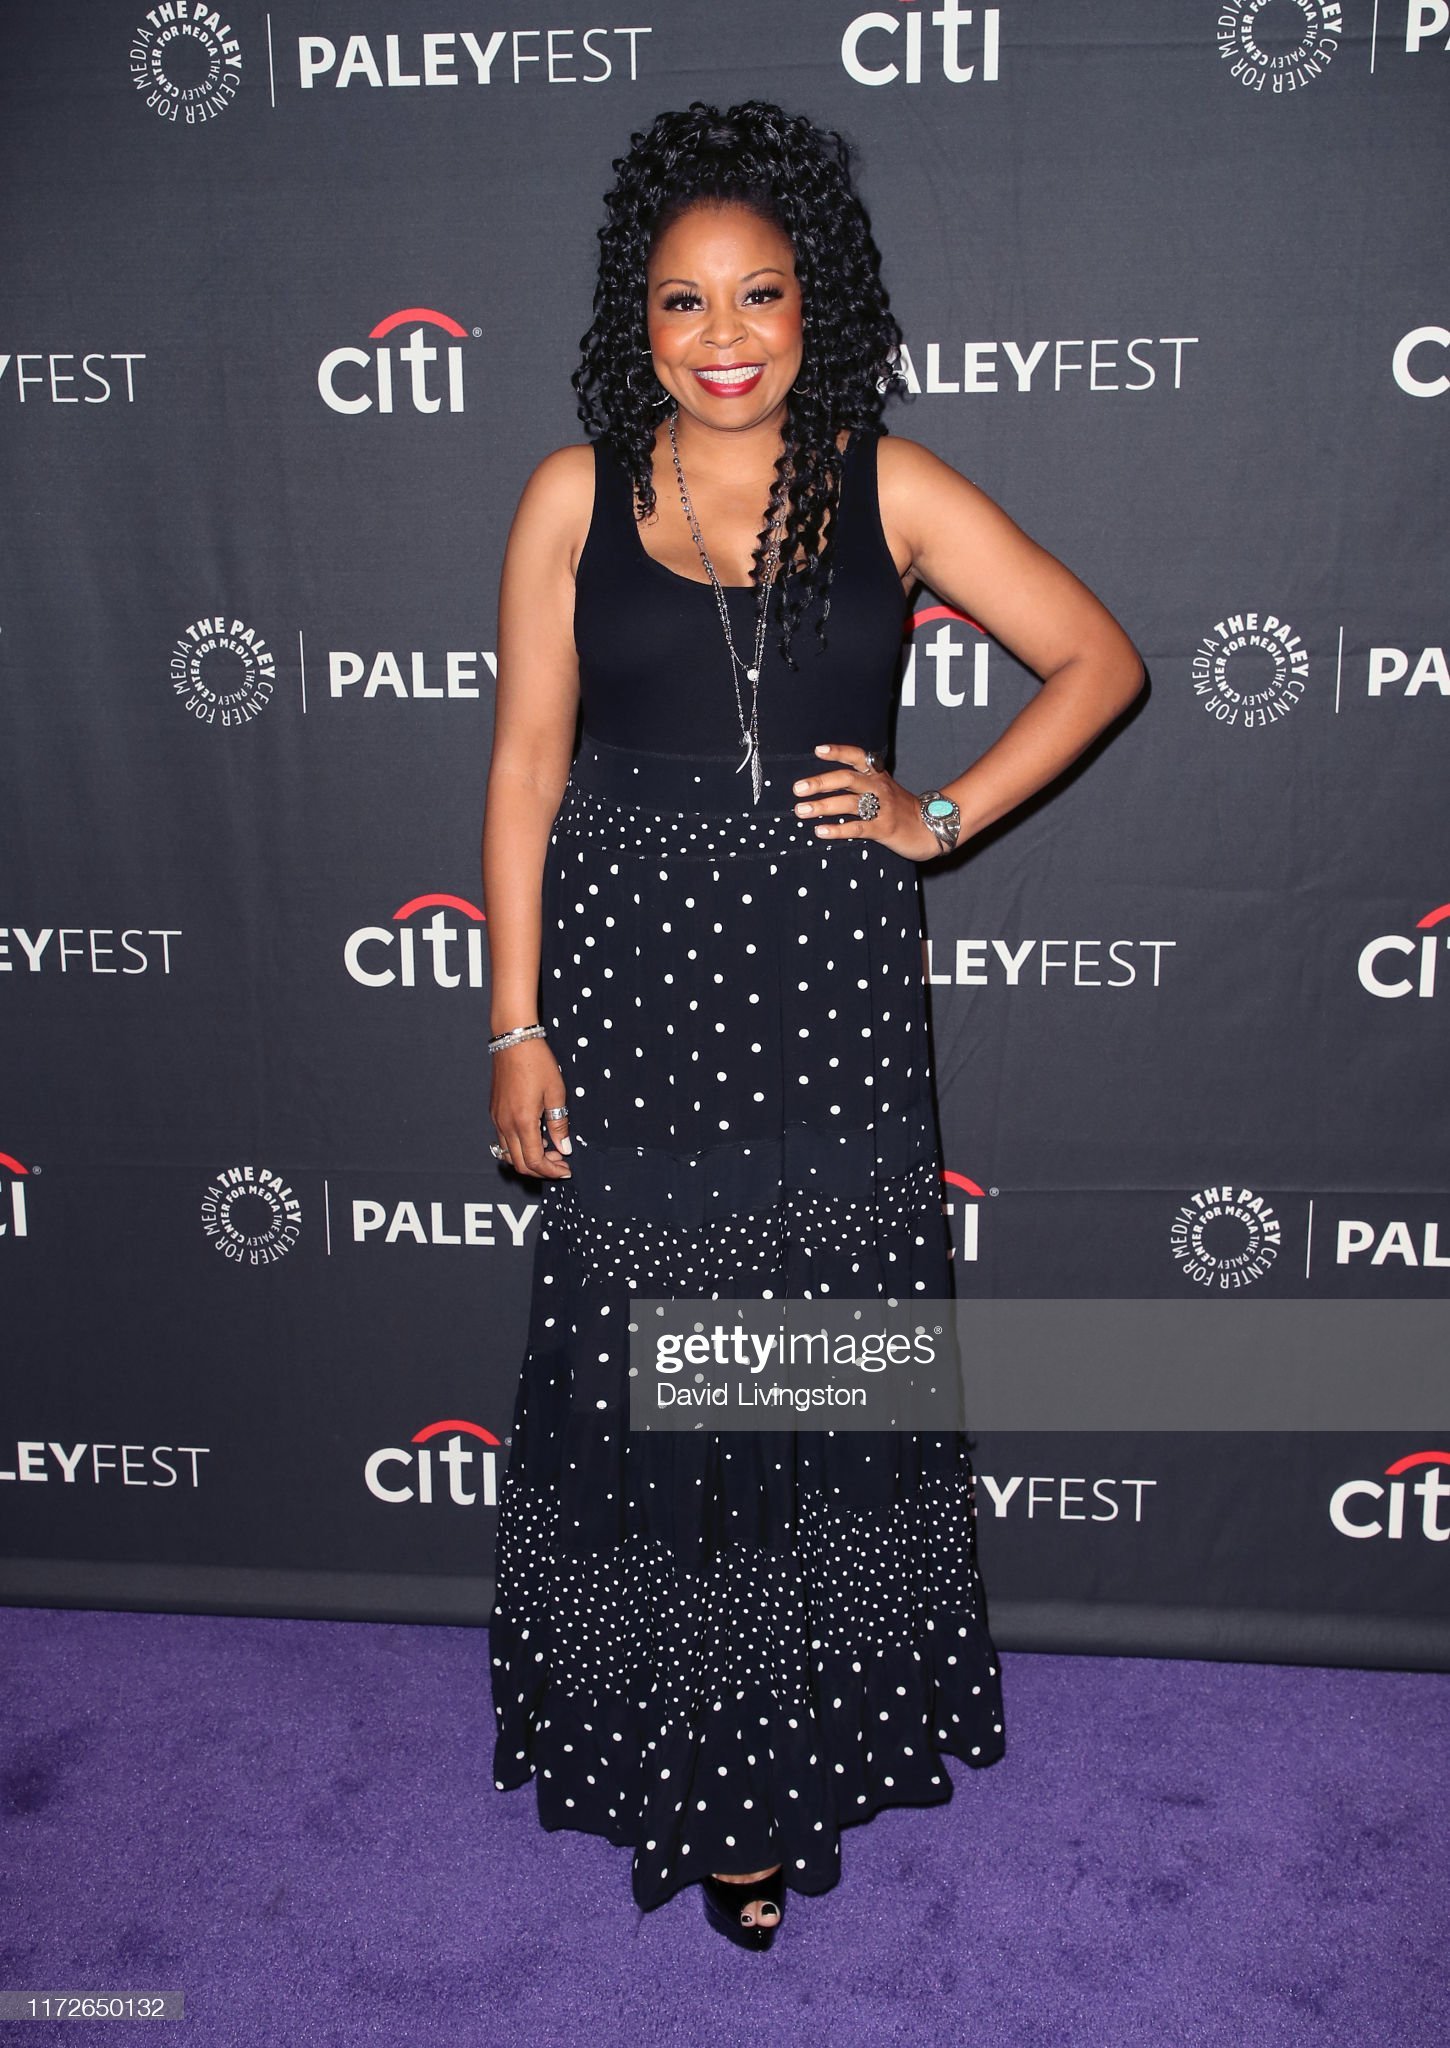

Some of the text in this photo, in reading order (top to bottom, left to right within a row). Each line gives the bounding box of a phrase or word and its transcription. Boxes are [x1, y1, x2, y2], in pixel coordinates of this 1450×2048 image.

[130, 1, 242, 123] THE PALEY CENTER FOR MEDIA
[298, 27, 652, 89] PALEYFEST
[841, 0, 999, 86] citi
[1231, 58, 1266, 91] FOR
[1273, 38, 1338, 93] CENTER
[317, 328, 464, 415] citi
[171, 617, 275, 726] THE PALEY CENTER FOR MEDIA
[1192, 613, 1309, 727] THE PALEY CENTER FOR MEDIA
[344, 911, 483, 987] citi
[1357, 935, 1450, 998] ci
[202, 1167, 301, 1265] THE PALEY CENTER FOR MEDIA
[352, 1200, 539, 1246] PALEY
[1171, 1186, 1280, 1288] THE PALEY CENTER FOR MEDIA
[364, 1435, 497, 1506] citi
[969, 1475, 1157, 1522] YFEST
